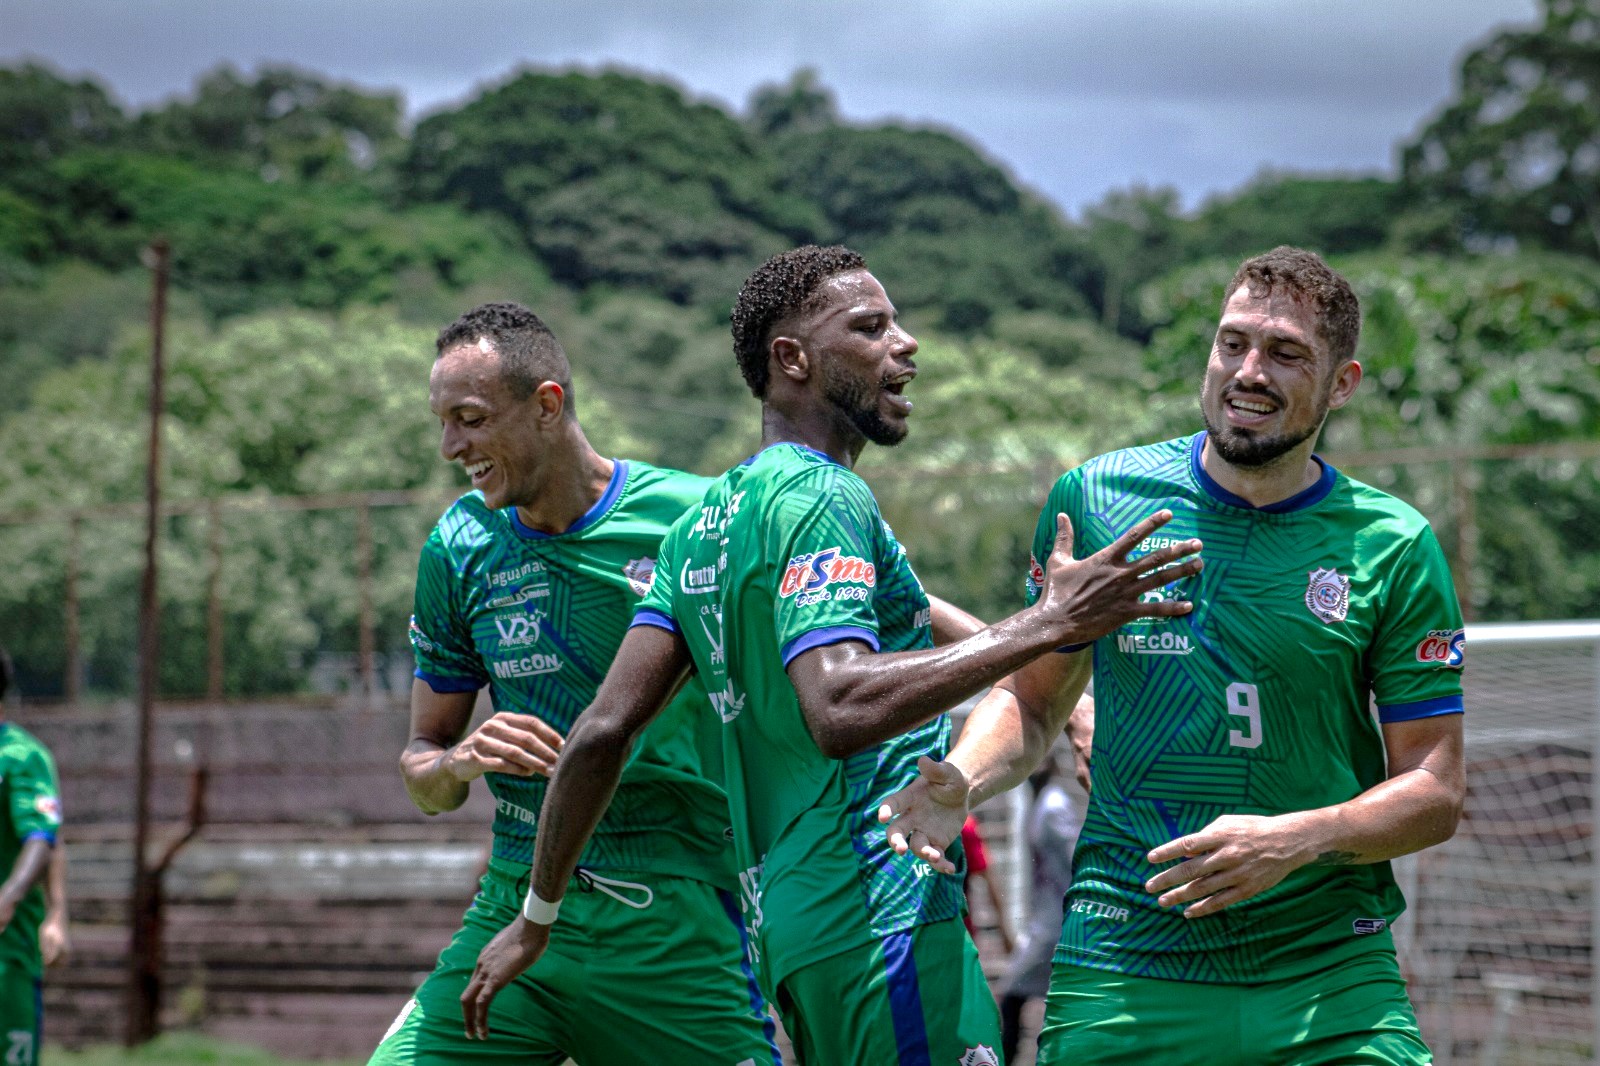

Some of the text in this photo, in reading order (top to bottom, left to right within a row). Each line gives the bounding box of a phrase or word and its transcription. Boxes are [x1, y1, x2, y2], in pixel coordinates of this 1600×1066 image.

[836, 587, 867, 601] 1967
[1118, 632, 1190, 654] MECON
[493, 654, 560, 679] MECON
[1226, 682, 1262, 749] 9
[1071, 899, 1129, 922] VETTOR
